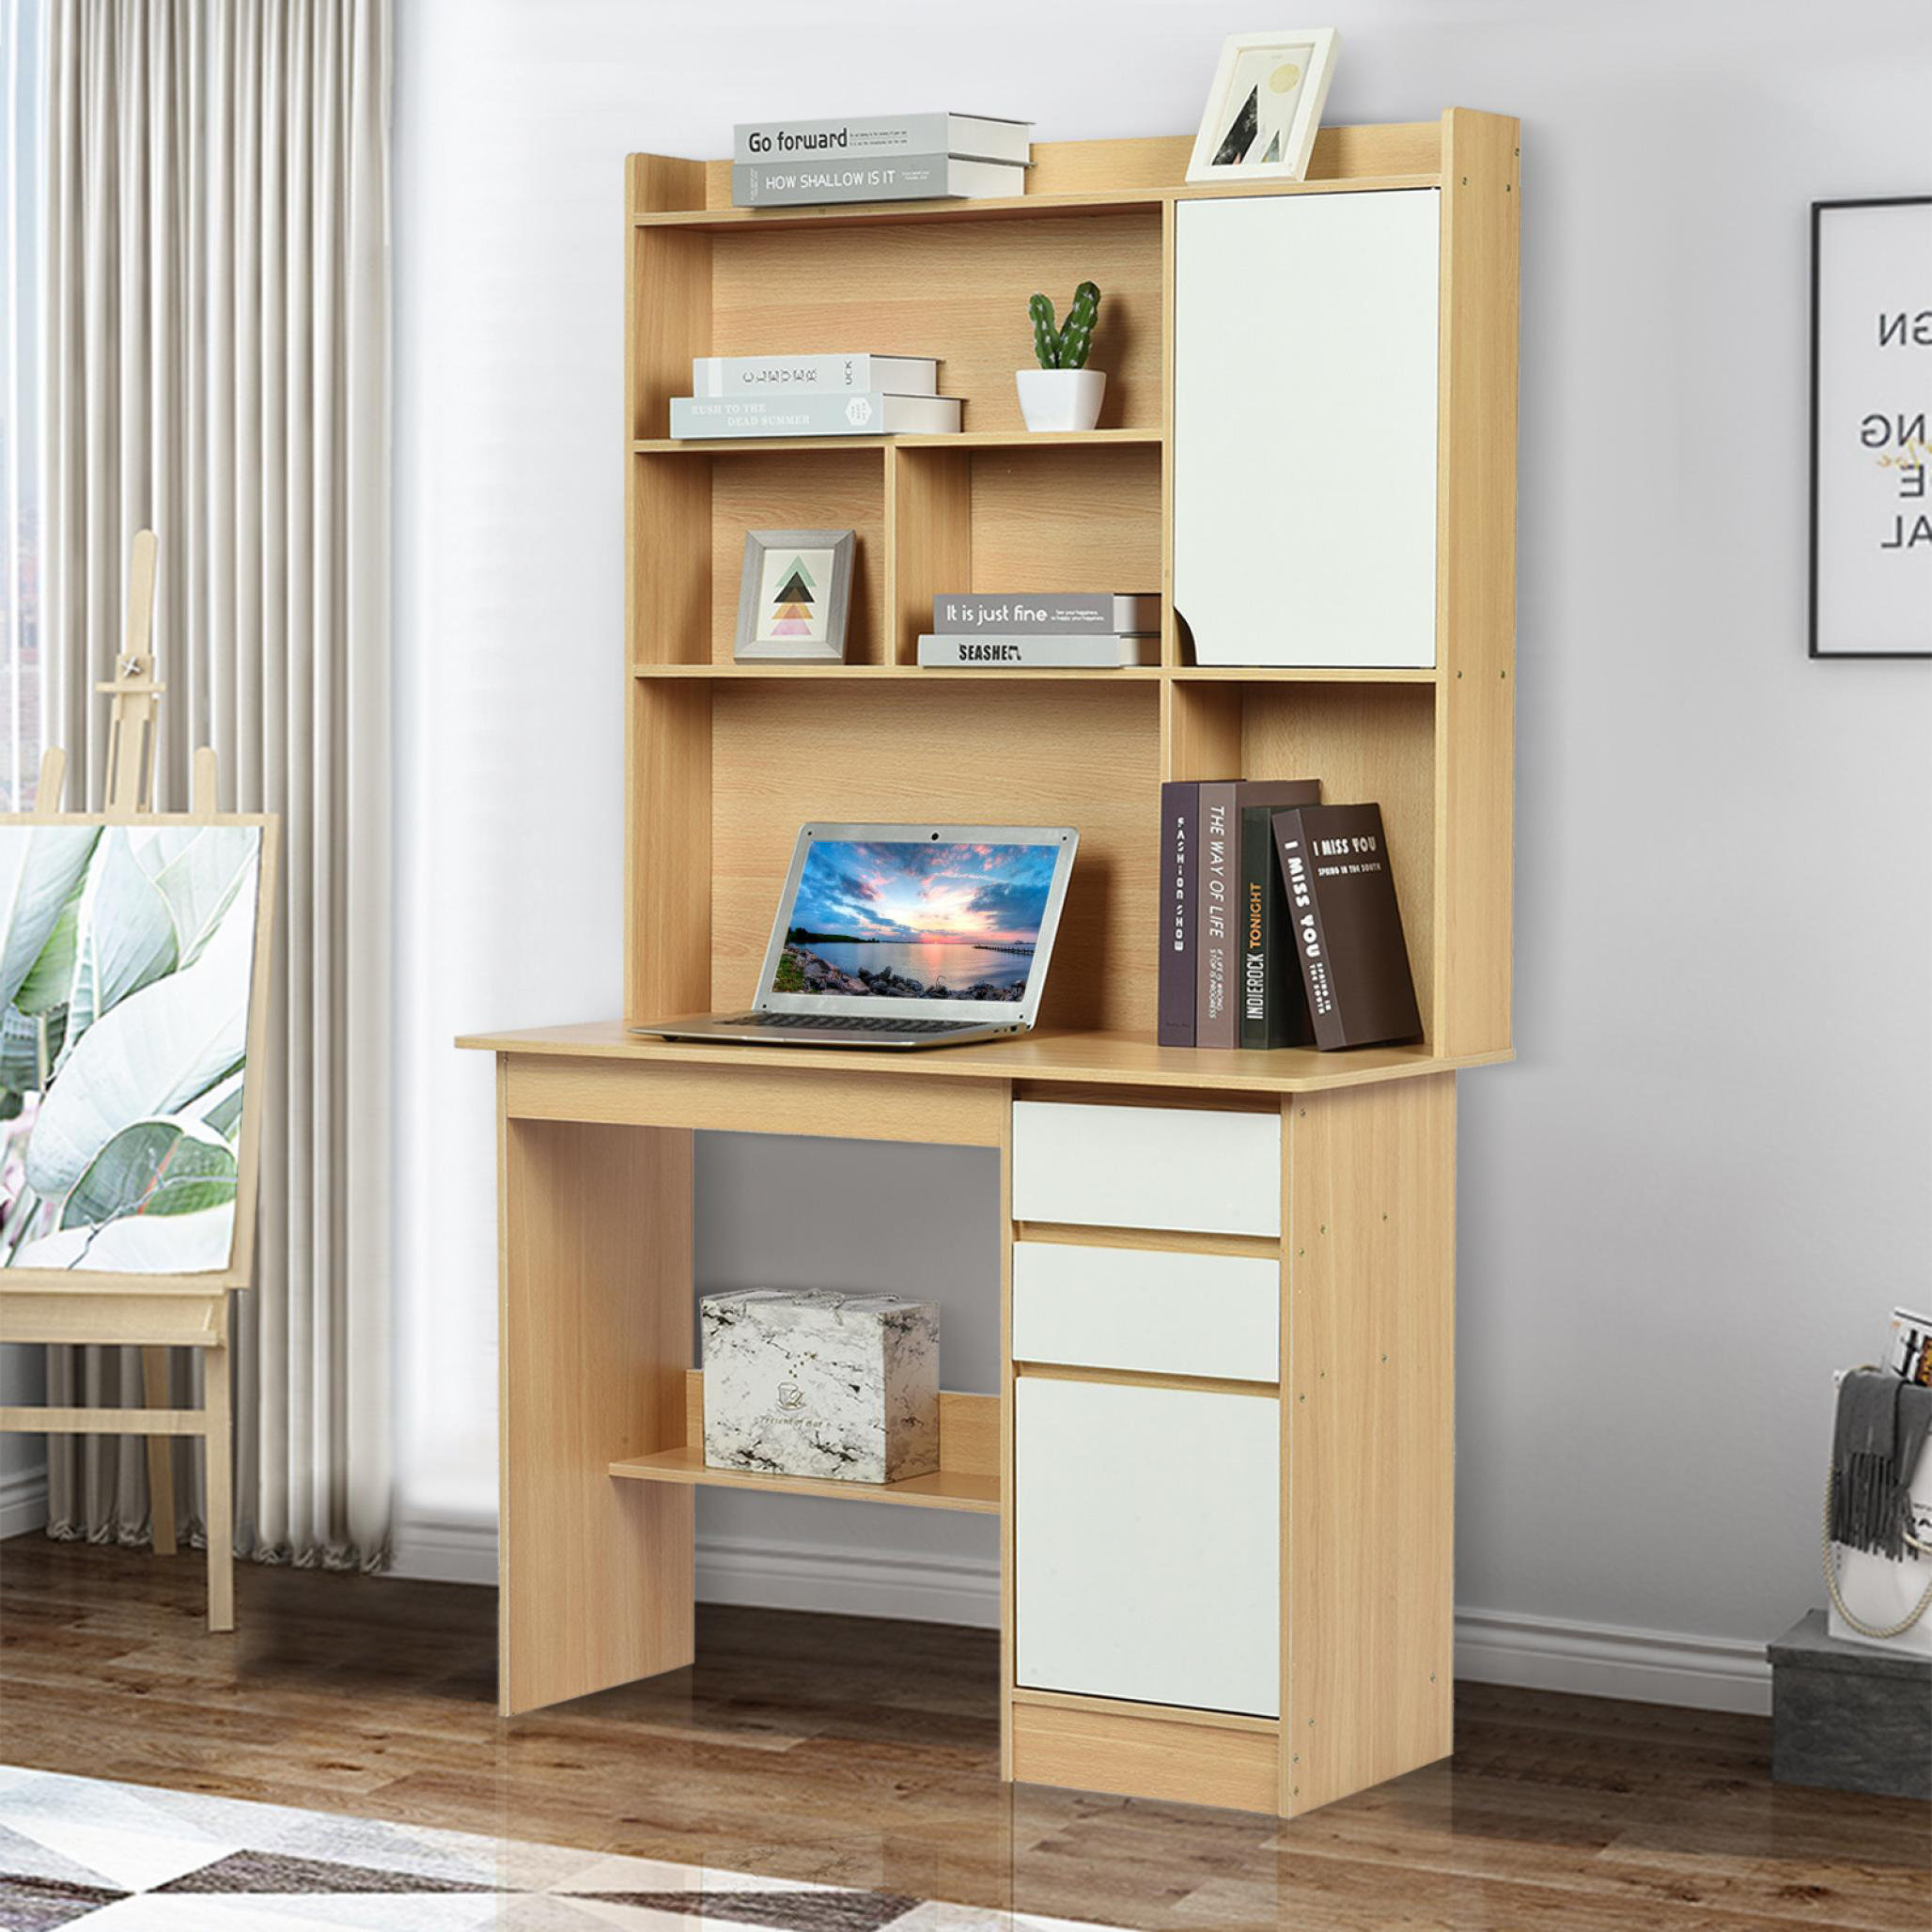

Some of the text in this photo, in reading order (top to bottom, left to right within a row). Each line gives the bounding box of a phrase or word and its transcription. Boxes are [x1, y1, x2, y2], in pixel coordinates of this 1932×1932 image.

[749, 127, 848, 152] Go forward
[766, 176, 797, 190] HOW
[800, 171, 865, 189] SHALLOW
[867, 171, 880, 186] IS
[882, 170, 896, 184] IT
[692, 403, 768, 415] RUSH TO THE
[727, 413, 811, 427] DEAD SUMMER
[946, 604, 1049, 627] It is just fine
[1313, 835, 1377, 856] I MISS YOU
[1208, 805, 1225, 940] THE WAY OF LIFE
[1284, 841, 1321, 958] I MISS YOU
[1246, 882, 1264, 1020] INDIEROCK TONIGHT
